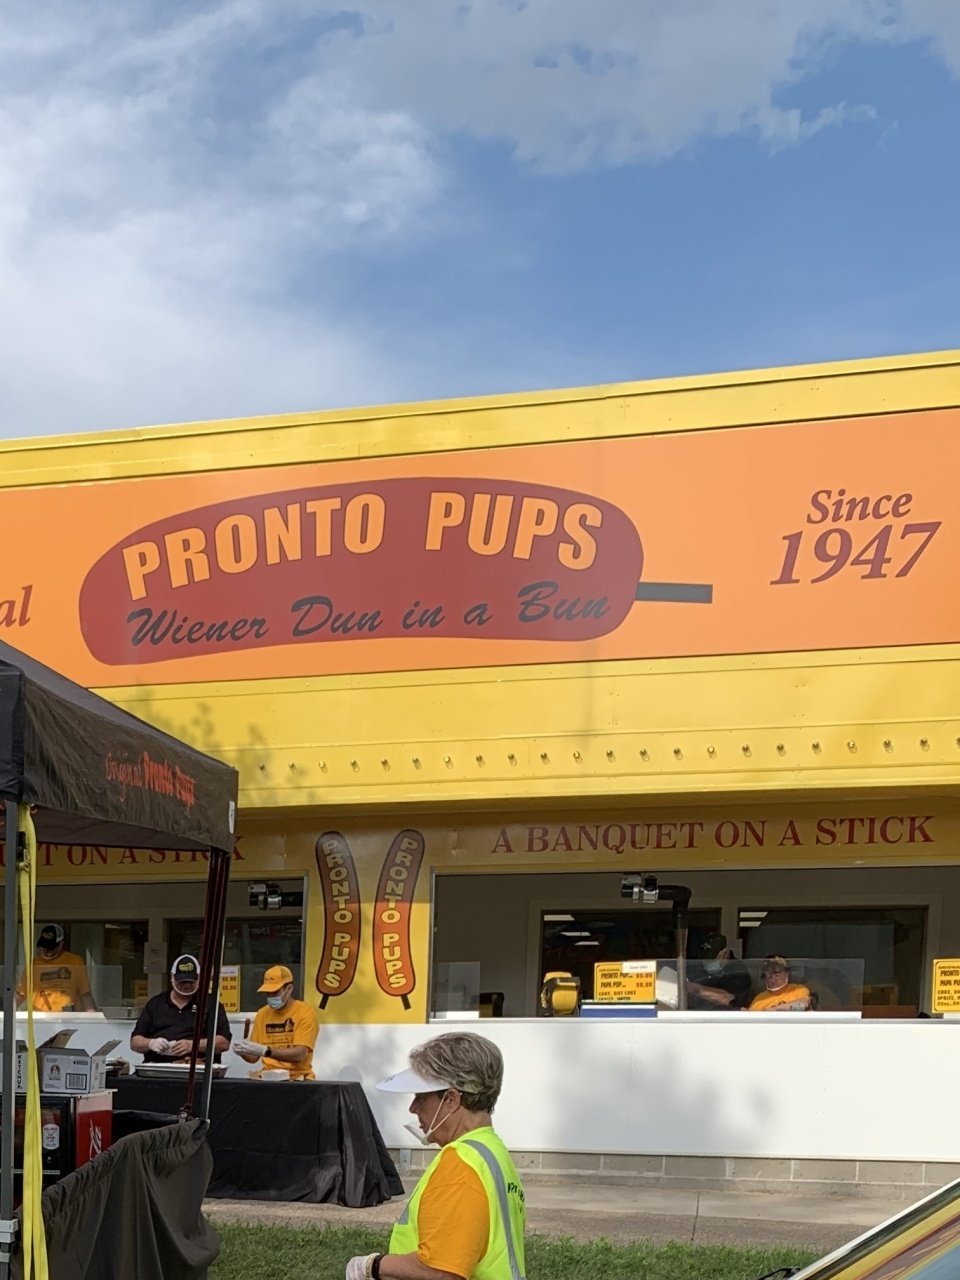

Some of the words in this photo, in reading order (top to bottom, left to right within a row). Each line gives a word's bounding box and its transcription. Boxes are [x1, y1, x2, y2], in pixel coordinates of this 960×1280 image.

[806, 488, 914, 525] Since
[122, 493, 386, 601] PRONTO
[424, 491, 604, 571] PUPS
[769, 520, 943, 586] 1947
[126, 607, 270, 647] Wiener
[290, 595, 384, 637] Dun
[402, 600, 445, 631] in
[463, 602, 492, 626] a
[517, 580, 611, 623] Bun
[66, 845, 109, 866] ON
[118, 846, 138, 865] A
[492, 827, 514, 854] A
[525, 821, 704, 854] BANQUET
[714, 819, 768, 849] ON
[778, 819, 804, 846] A
[815, 815, 936, 846] STICK
[321, 839, 353, 924] PRONTO
[381, 837, 419, 924] PRONTO
[323, 932, 352, 988] PUPS
[382, 933, 408, 989] PUPS
